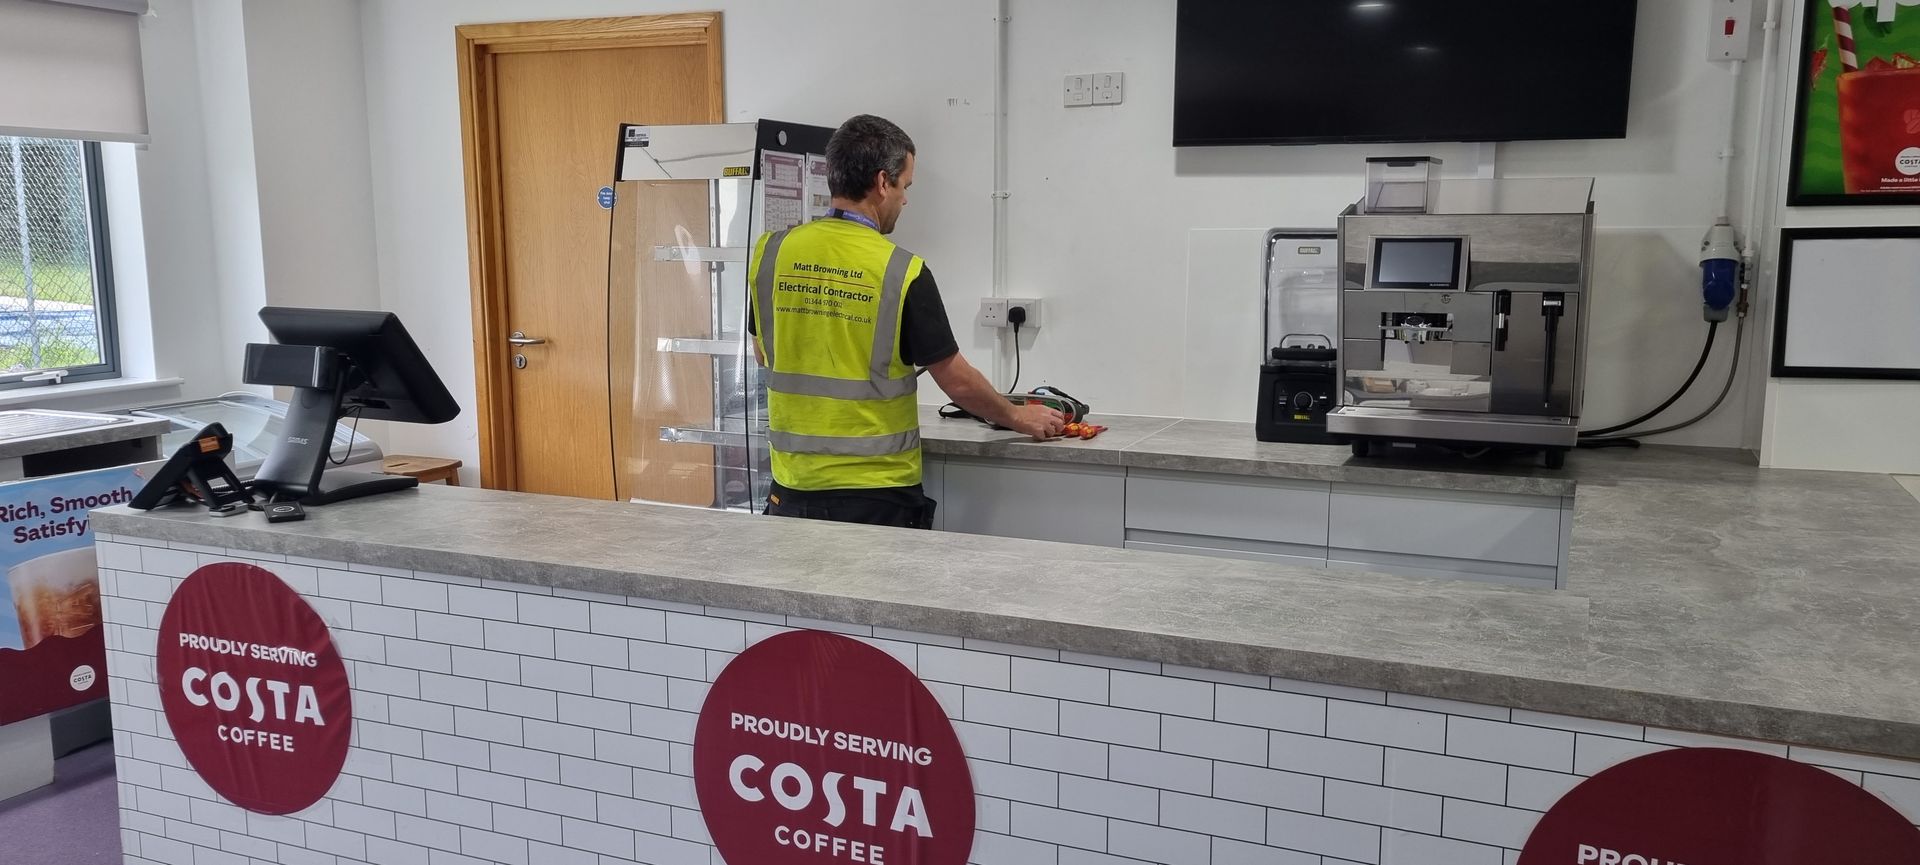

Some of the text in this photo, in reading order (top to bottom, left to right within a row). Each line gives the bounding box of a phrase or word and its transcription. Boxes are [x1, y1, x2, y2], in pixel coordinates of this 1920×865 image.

[793, 262, 863, 279] Matt Browning Ltd
[778, 281, 873, 303] Electrical Contractor
[0, 486, 133, 523] Rich, Smooth
[179, 632, 318, 668] PROUDLY SERVING
[74, 674, 92, 683] COSTA
[181, 666, 326, 726] COSTA
[217, 724, 295, 752] COFFEE
[731, 712, 933, 766] PROUDLY SERVING
[729, 754, 934, 838] COSTA
[774, 825, 885, 865] COFFEE
